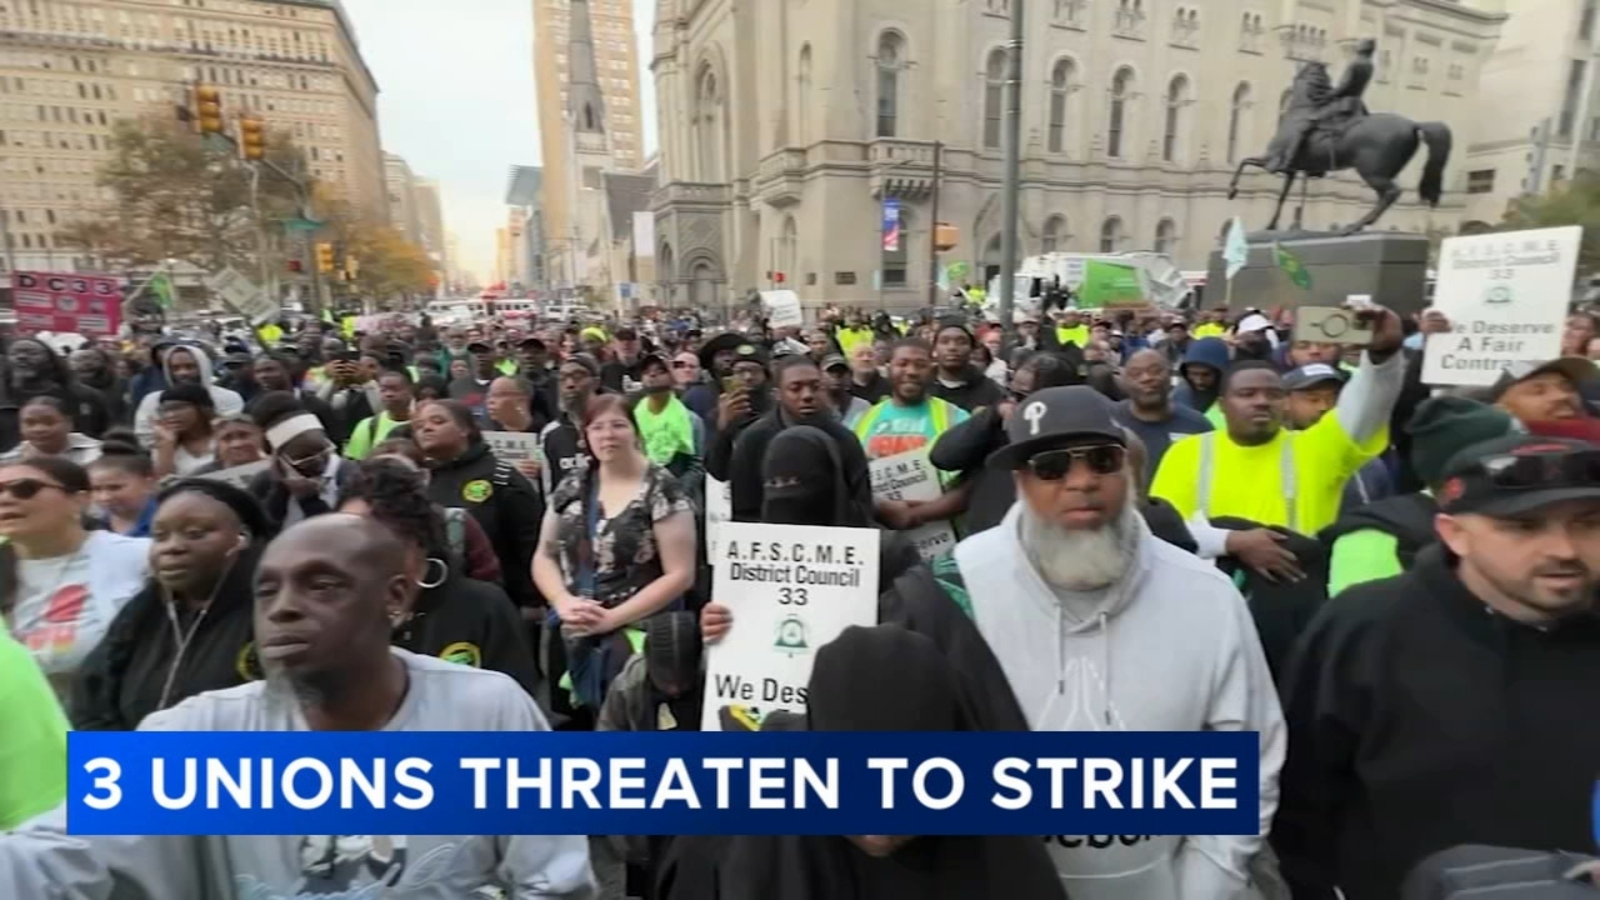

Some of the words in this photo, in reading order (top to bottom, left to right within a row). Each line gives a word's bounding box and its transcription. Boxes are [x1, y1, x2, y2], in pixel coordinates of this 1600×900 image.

[1472, 320, 1555, 334] Deserve
[1457, 337, 1473, 350] A
[1480, 336, 1525, 351] Fair
[1440, 353, 1513, 371] Contra
[1024, 401, 1047, 435] P
[727, 541, 865, 566] A.F.S.C.M.E.
[730, 562, 791, 583] District
[795, 565, 860, 587] Council
[777, 587, 808, 606] 33
[715, 674, 754, 701] We
[763, 678, 809, 705] Des
